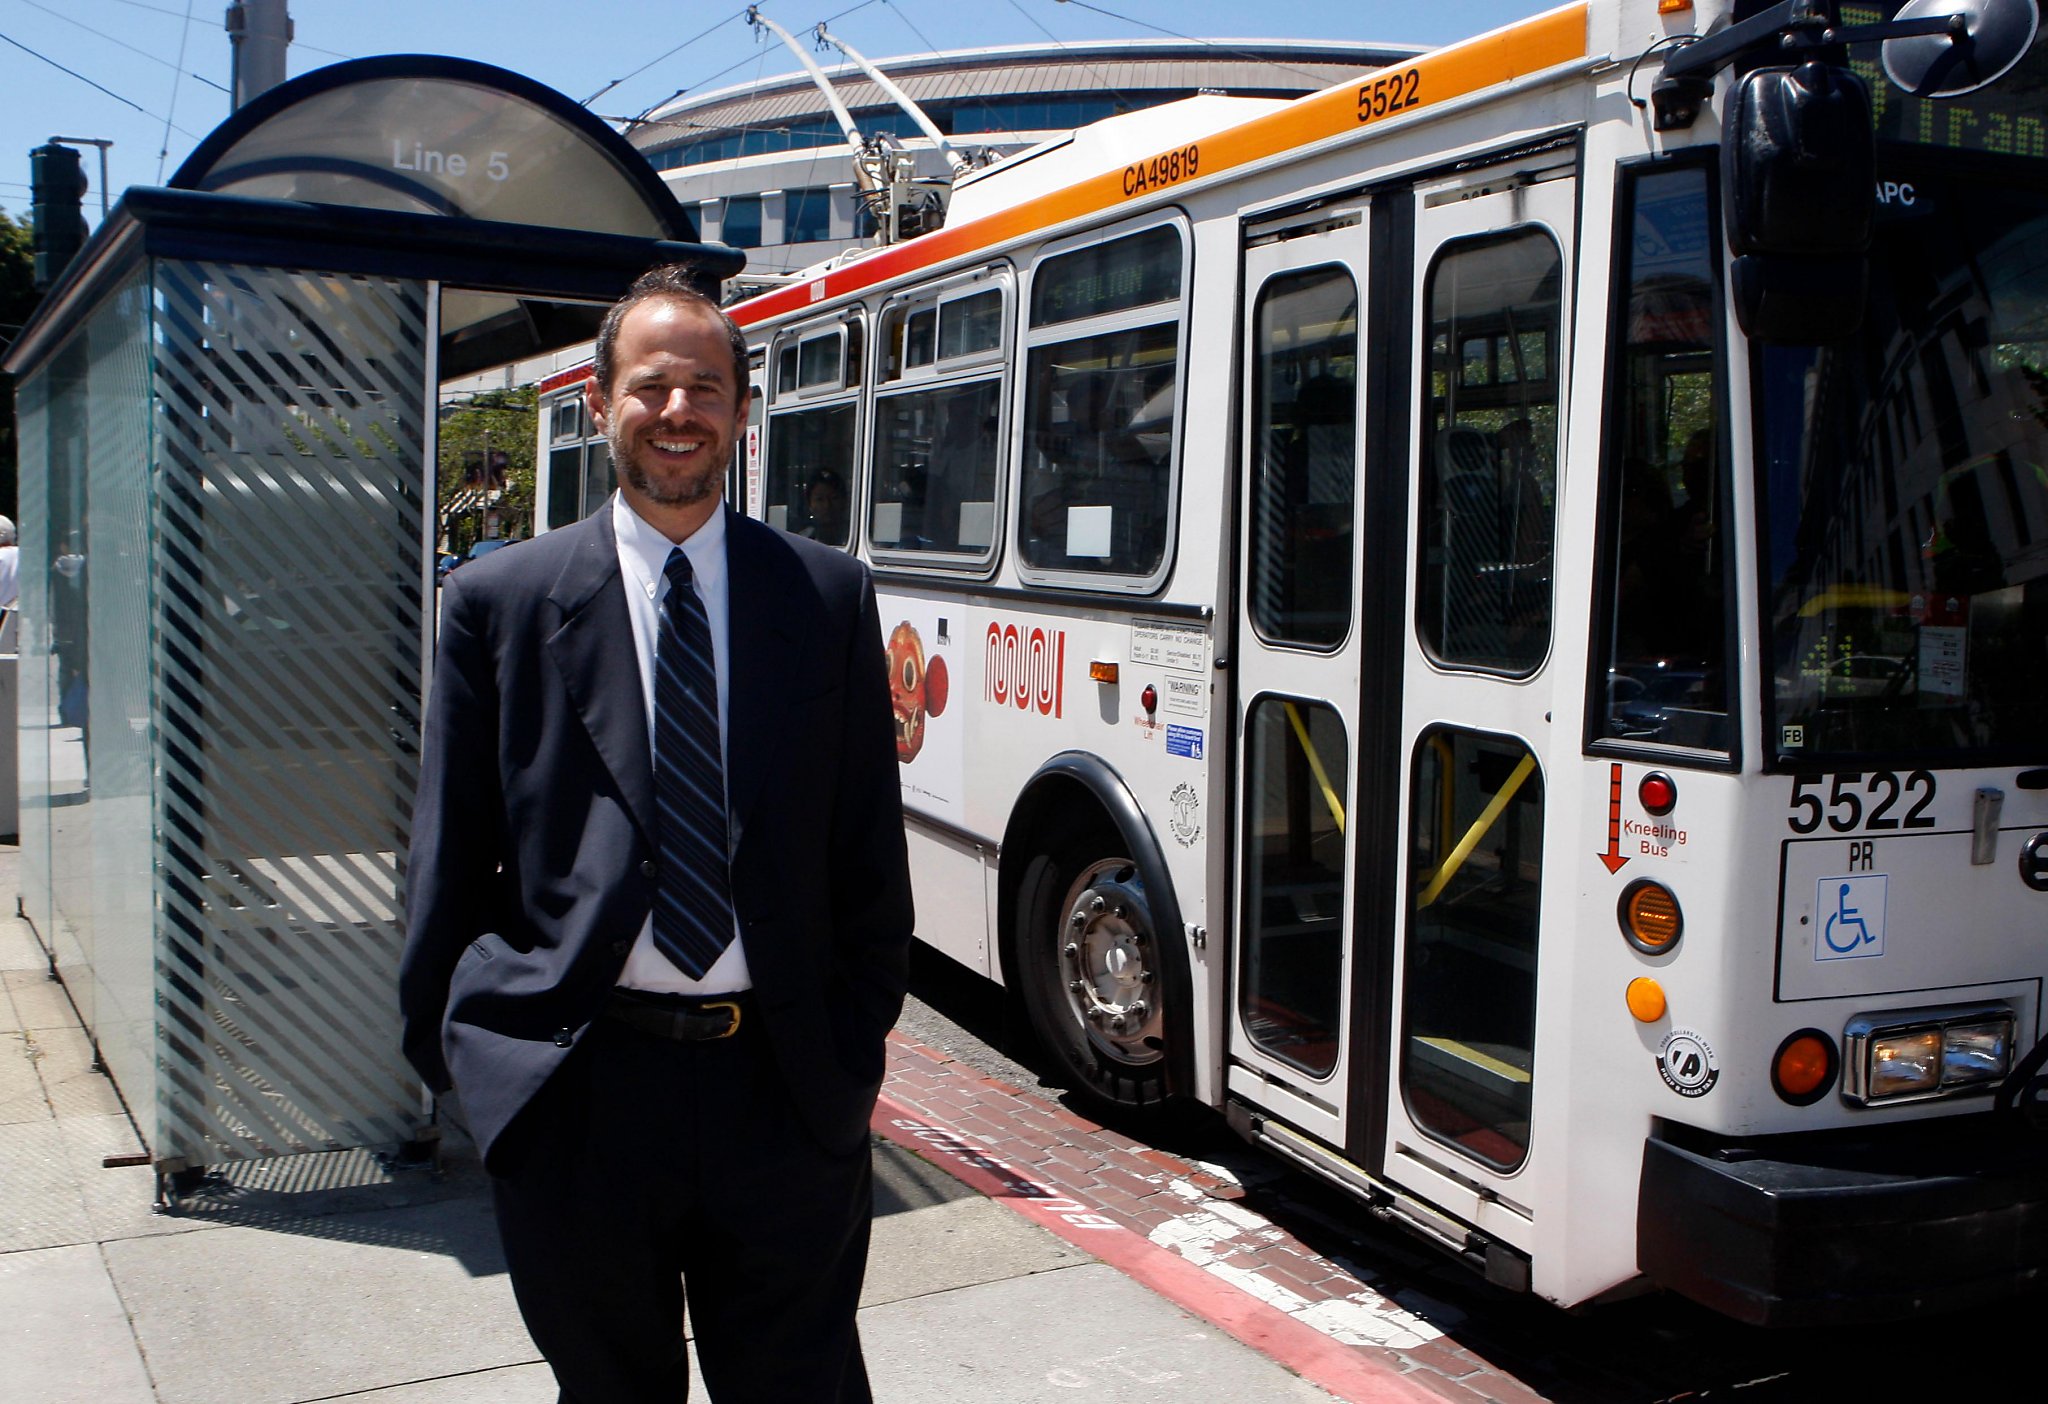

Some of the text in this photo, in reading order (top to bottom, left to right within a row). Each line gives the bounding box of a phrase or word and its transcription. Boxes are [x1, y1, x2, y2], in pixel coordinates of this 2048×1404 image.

[1357, 68, 1420, 123] 5522
[393, 139, 510, 181] Line 5
[1122, 144, 1200, 196] CA49819
[1134, 716, 1165, 731] Wheeair
[1783, 729, 1803, 743] FB
[1787, 770, 1937, 834] 5522
[1624, 819, 1687, 845] Kneeling
[1640, 840, 1668, 857] Bus
[1848, 841, 1874, 872] PR
[1660, 1067, 1675, 1086] PROP
[1682, 1087, 1703, 1096] SALES
